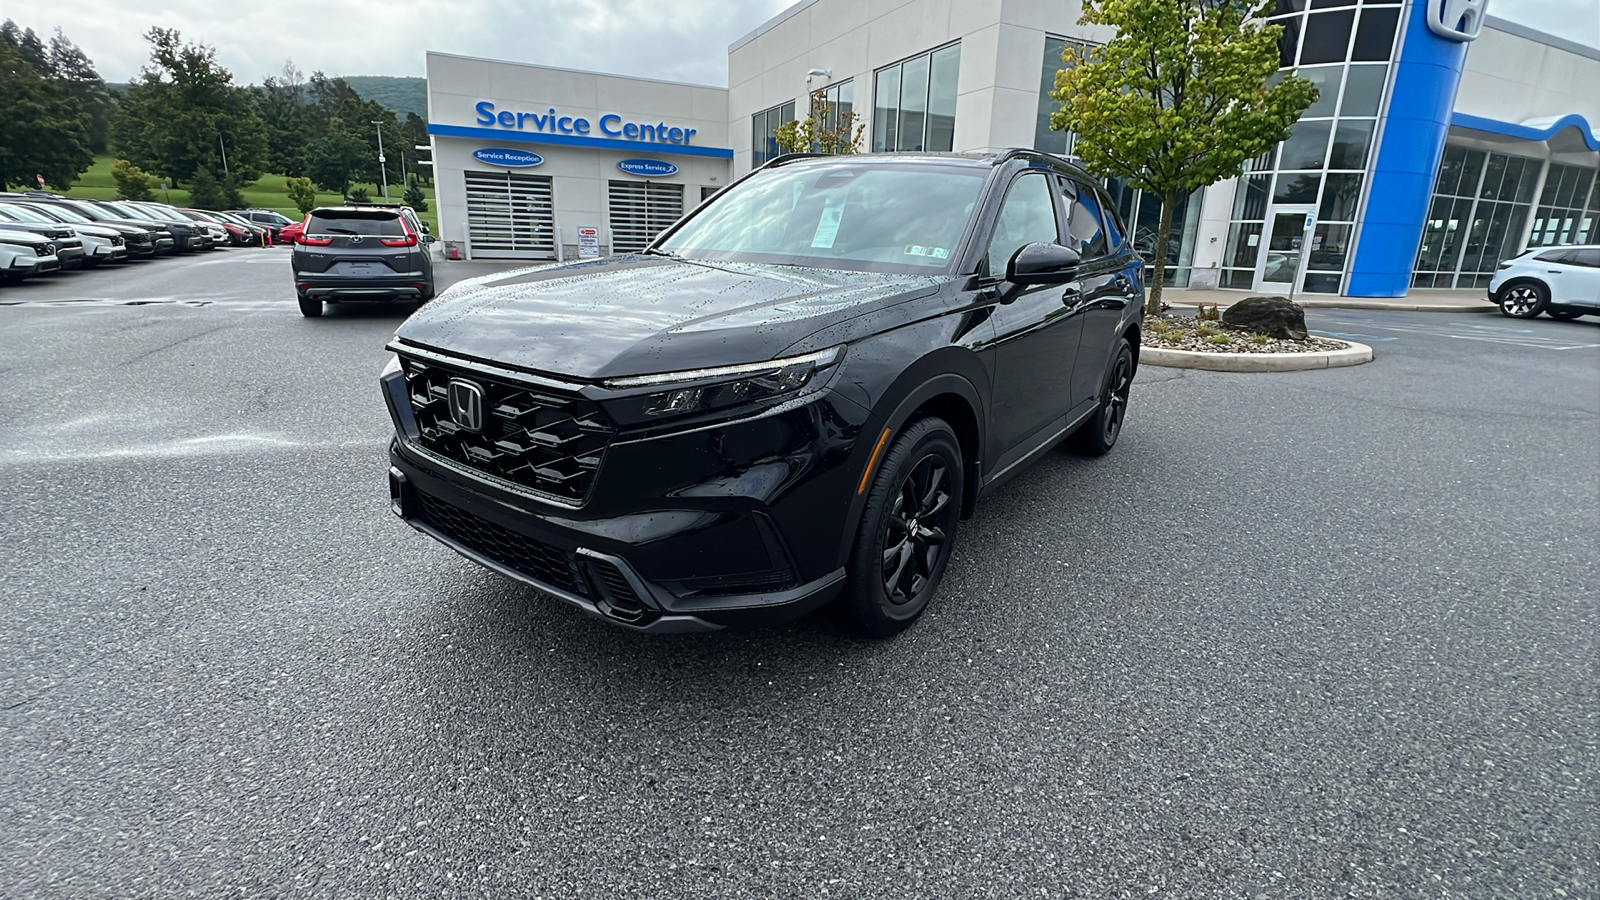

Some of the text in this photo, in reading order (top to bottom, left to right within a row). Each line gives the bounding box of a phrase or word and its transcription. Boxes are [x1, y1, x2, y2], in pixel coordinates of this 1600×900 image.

[475, 101, 697, 145] Service Center
[477, 151, 540, 162] Service Reception
[620, 162, 667, 171] Express Service
